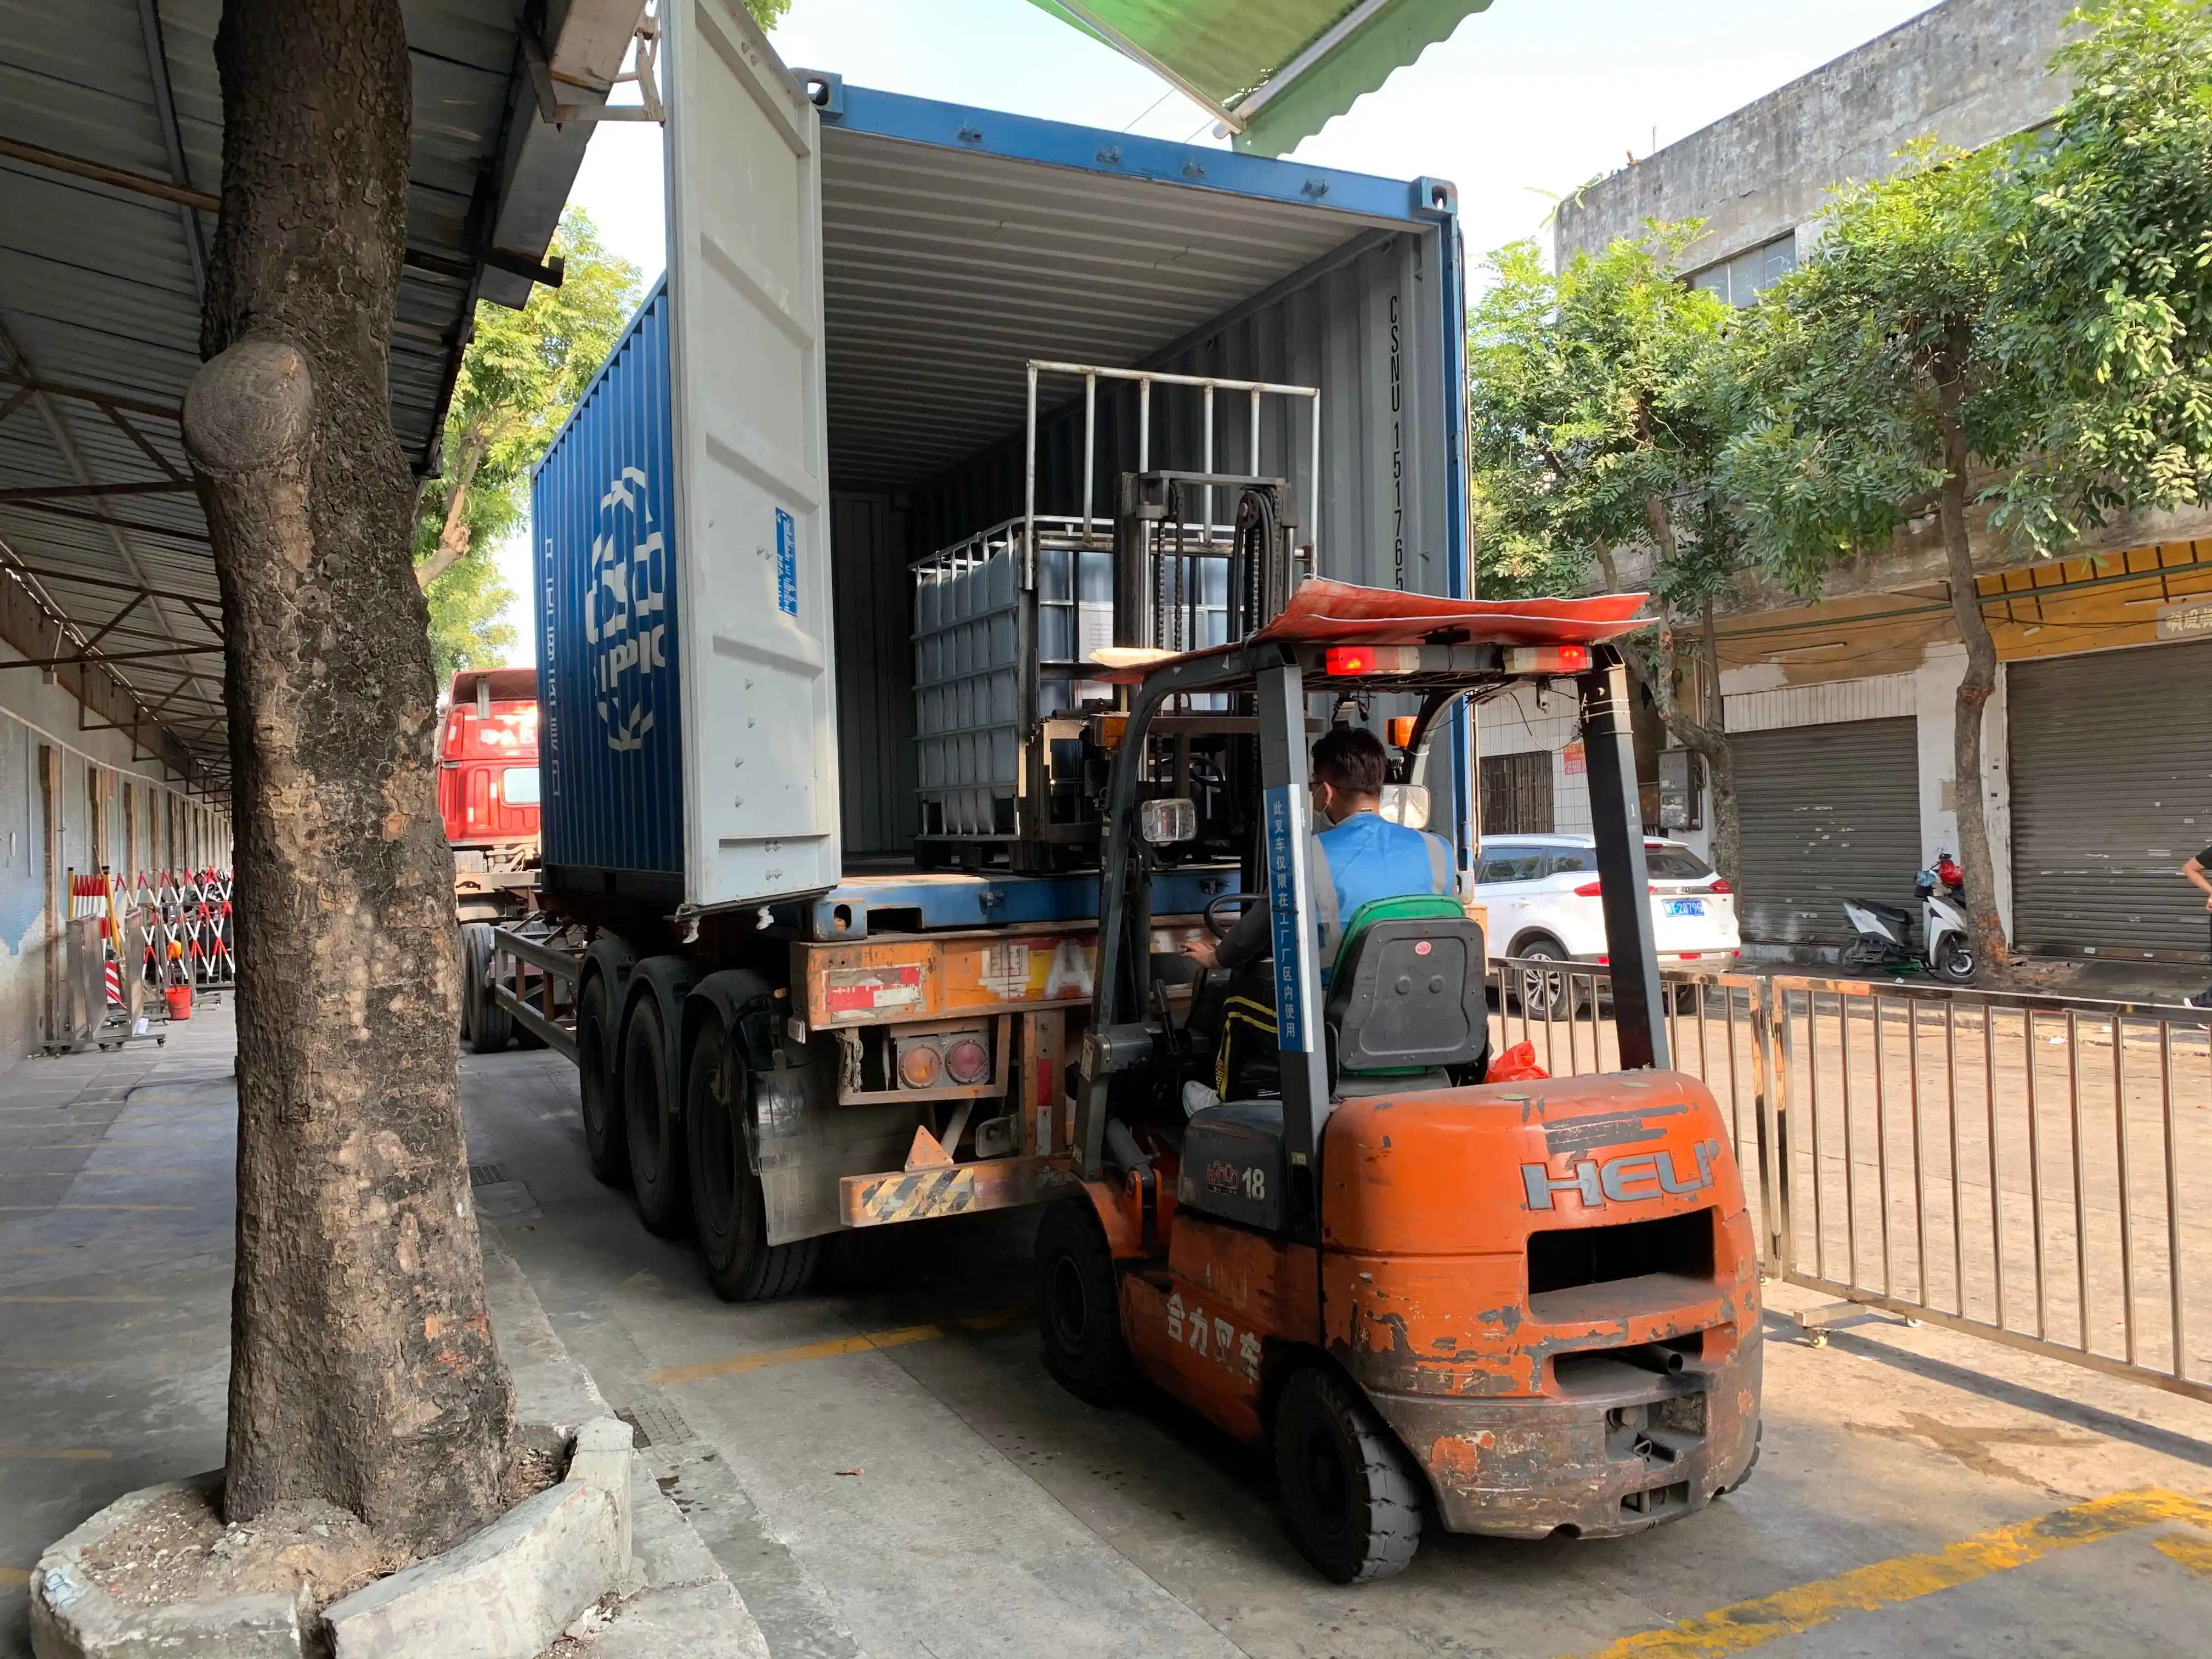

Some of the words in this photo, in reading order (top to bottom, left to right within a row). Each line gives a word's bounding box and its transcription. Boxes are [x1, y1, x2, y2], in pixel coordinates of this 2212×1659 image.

[1390, 296, 1401, 413] CSNU
[1392, 422, 1404, 591] 151765
[1273, 799, 1296, 1038] 此叉车仅限在工厂厂区内使用
[1242, 1167, 1265, 1201] 18
[1520, 1141, 1714, 1210] HELI
